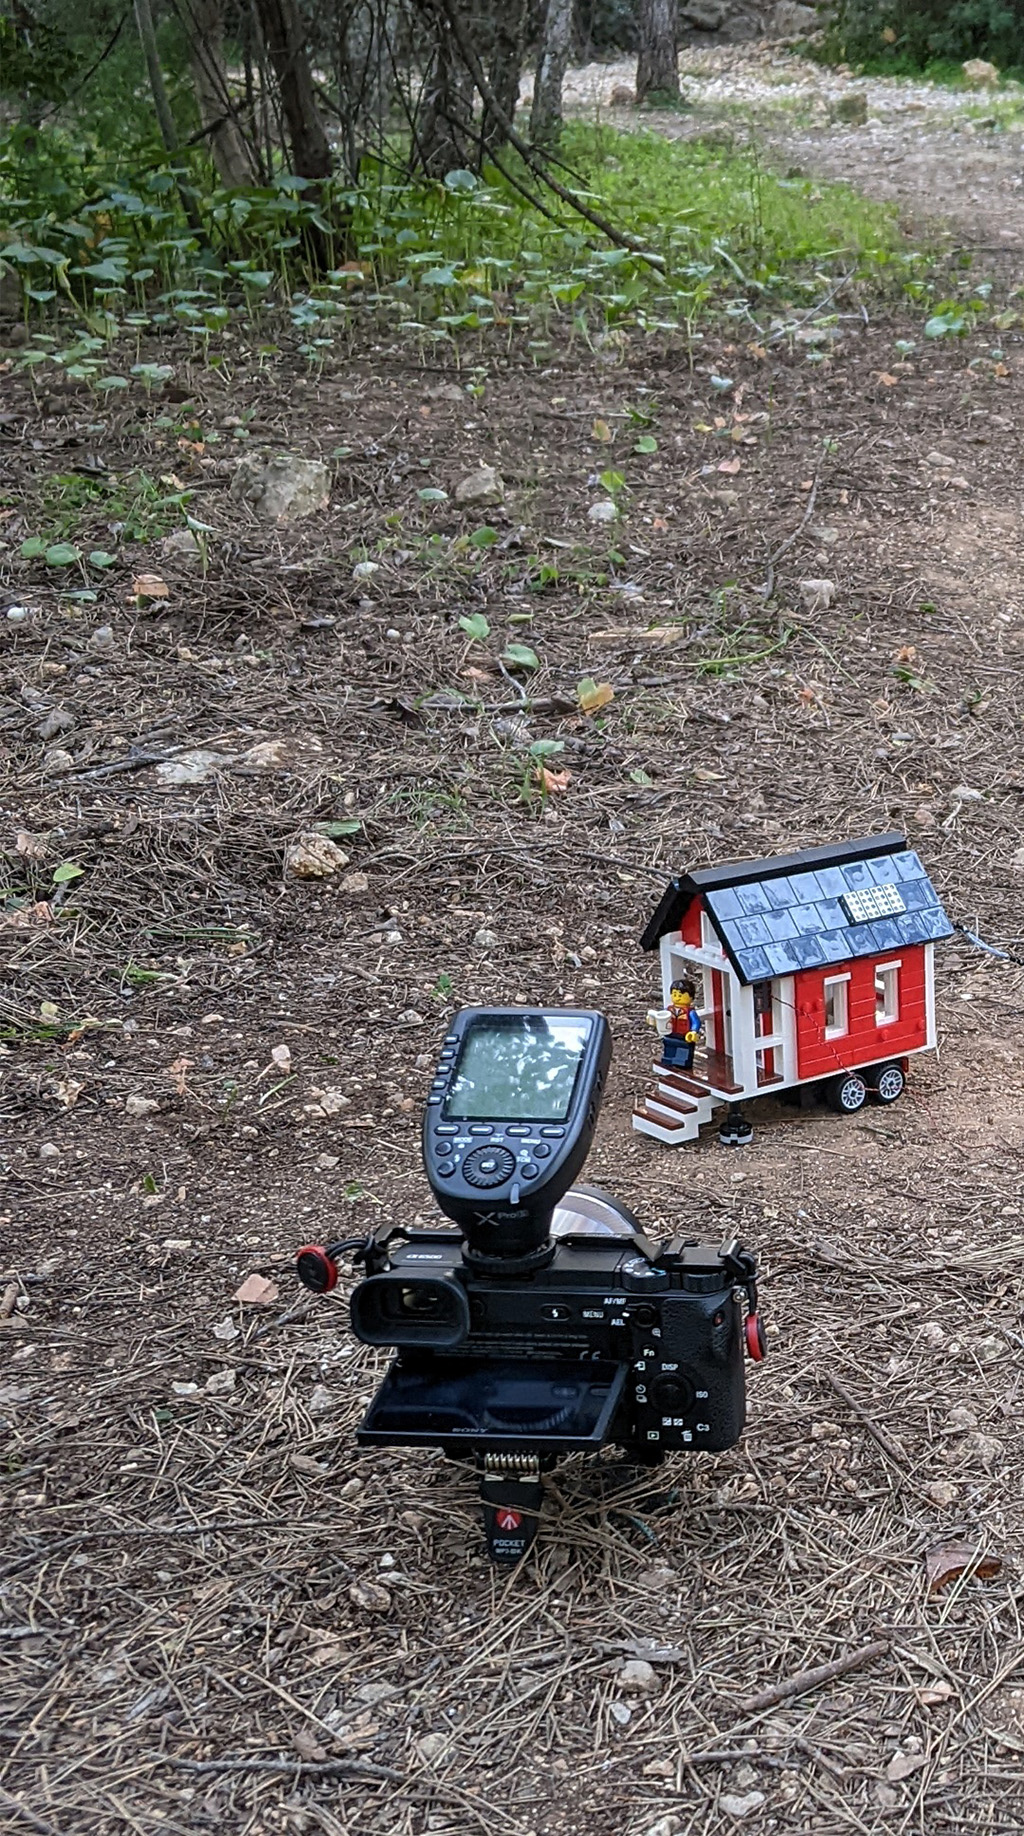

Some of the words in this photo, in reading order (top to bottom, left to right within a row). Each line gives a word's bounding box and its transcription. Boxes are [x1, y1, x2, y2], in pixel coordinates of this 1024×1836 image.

[603, 1297, 627, 1305] AF/MF
[582, 1310, 604, 1318] MENU
[610, 1318, 626, 1326] AEL
[643, 1348, 655, 1357] Fn
[661, 1363, 679, 1371] DISP
[695, 1390, 709, 1398] ISO
[696, 1423, 710, 1432] C3
[493, 1538, 525, 1547] POCKET
